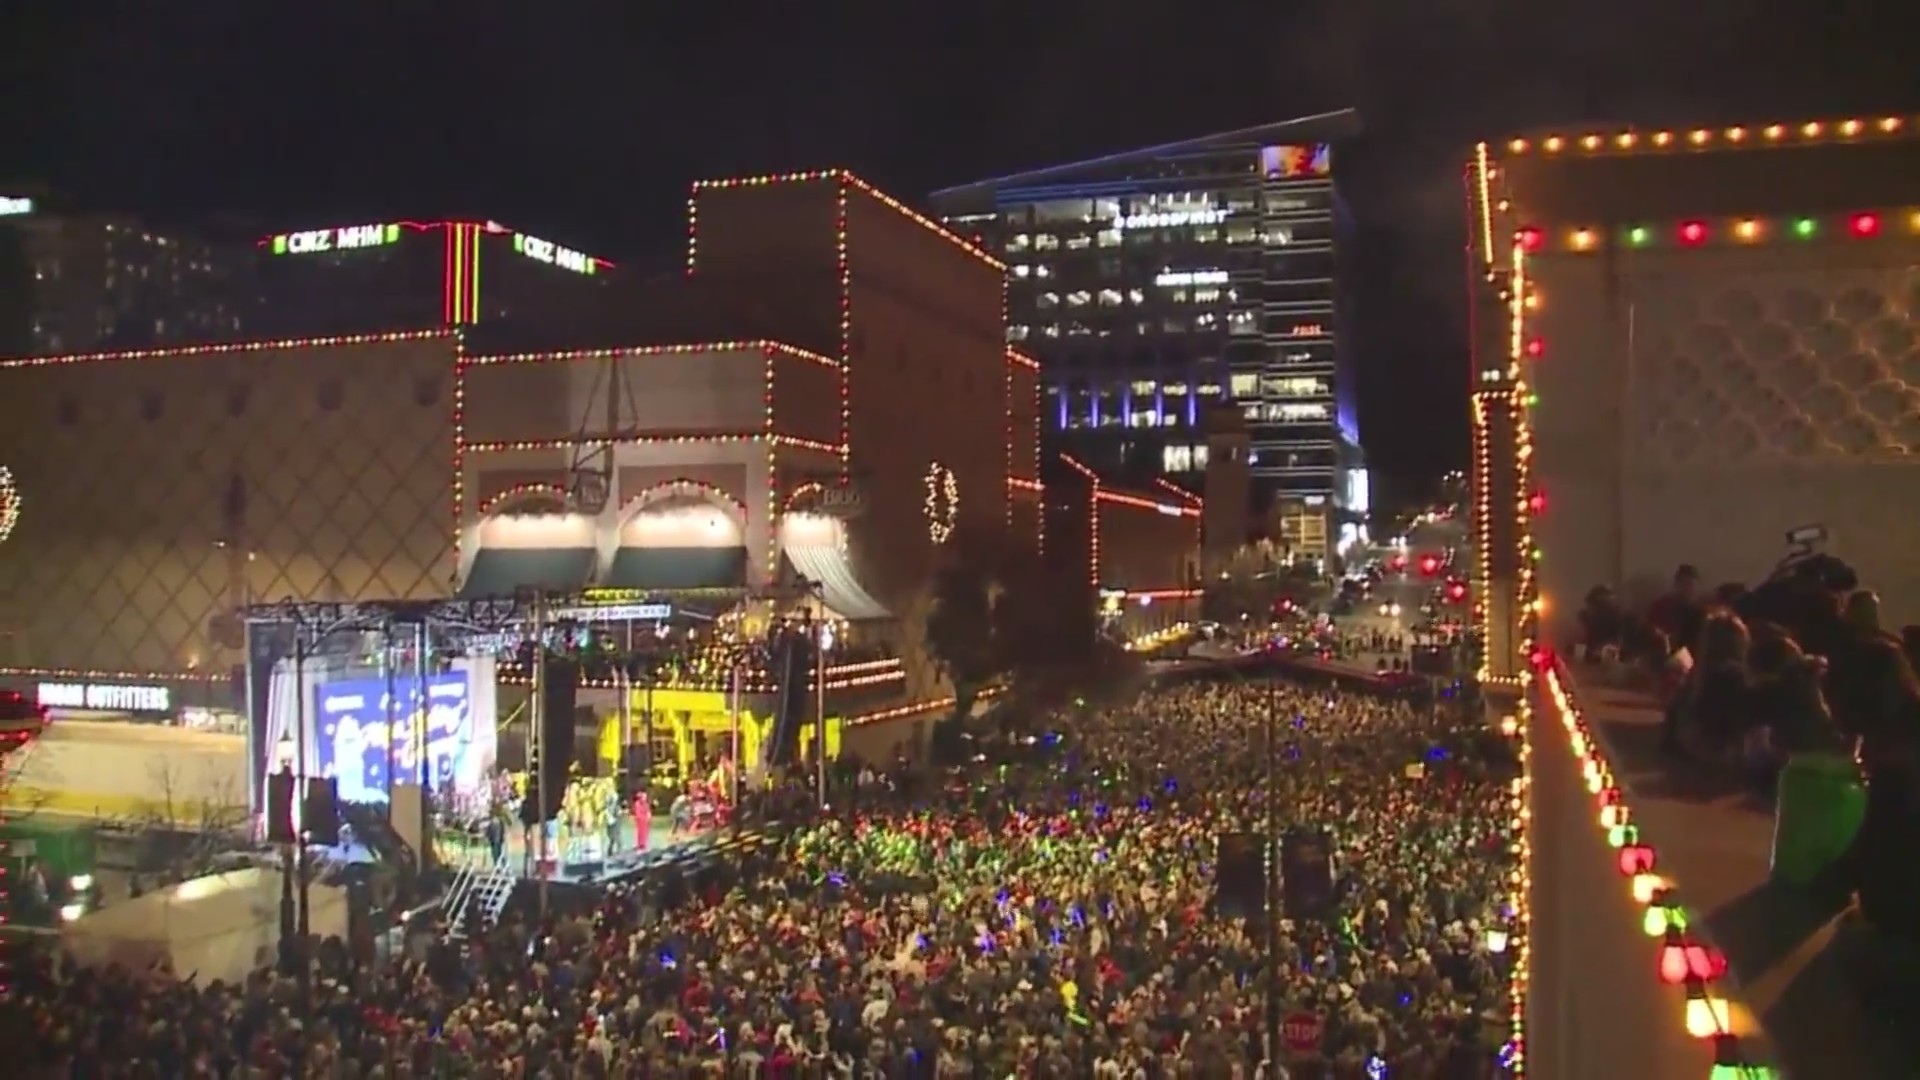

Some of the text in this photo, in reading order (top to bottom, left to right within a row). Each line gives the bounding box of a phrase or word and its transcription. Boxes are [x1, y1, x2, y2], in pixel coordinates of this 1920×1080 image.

[337, 224, 383, 249] MHM
[86, 685, 169, 711] OUTFITTERS
[1285, 1022, 1319, 1042] STOP
